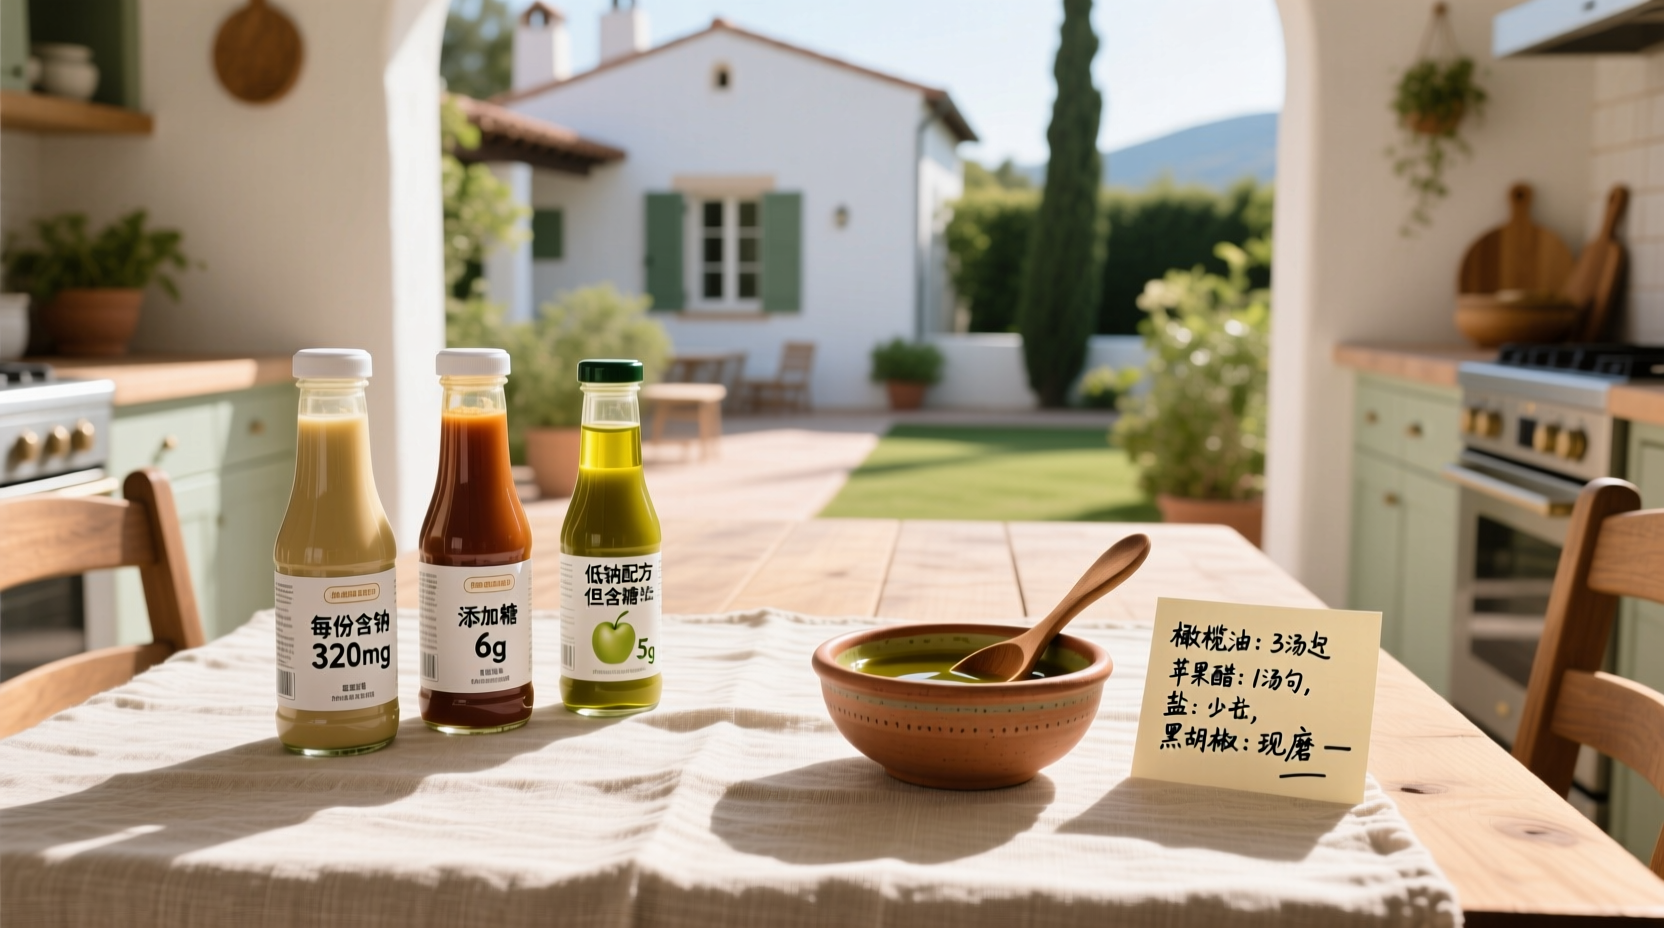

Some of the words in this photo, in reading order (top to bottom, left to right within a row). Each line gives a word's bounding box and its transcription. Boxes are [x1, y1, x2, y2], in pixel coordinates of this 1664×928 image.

[311, 609, 390, 639] 每份含钠
[458, 603, 518, 628] 添加糖
[311, 642, 391, 669] 320mg
[475, 632, 507, 663] 6g
[636, 638, 655, 664] 5g
